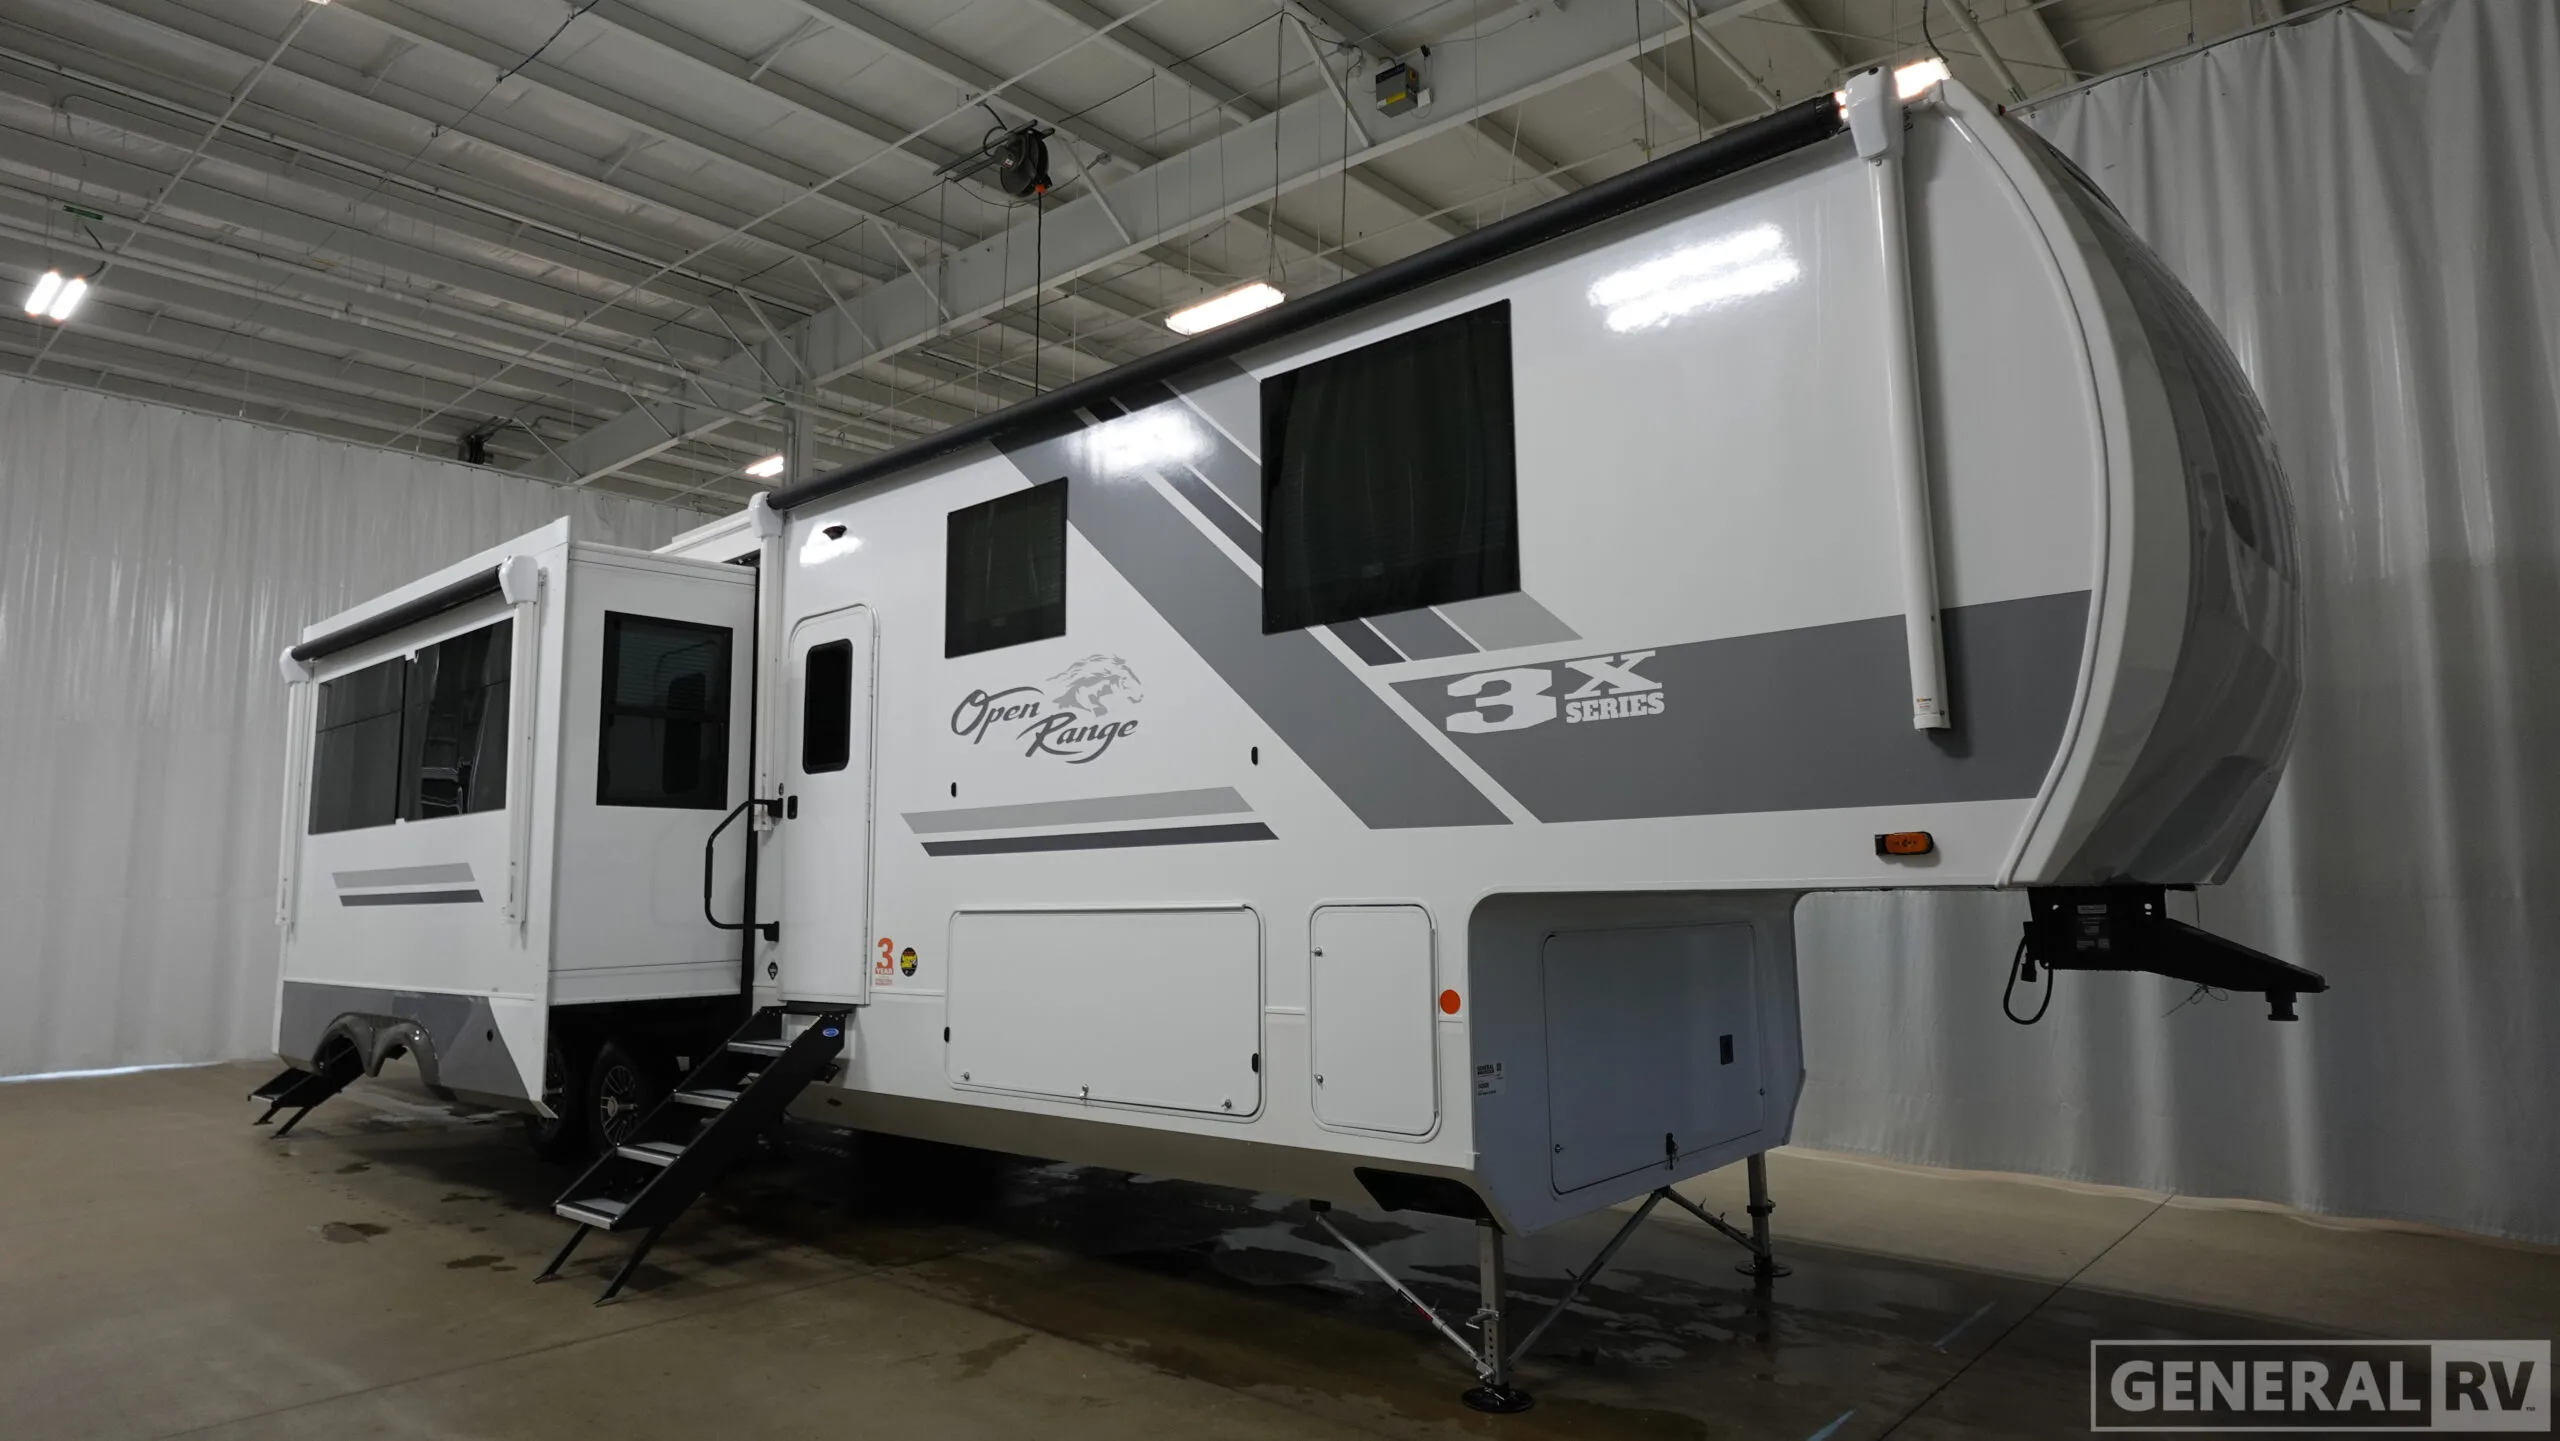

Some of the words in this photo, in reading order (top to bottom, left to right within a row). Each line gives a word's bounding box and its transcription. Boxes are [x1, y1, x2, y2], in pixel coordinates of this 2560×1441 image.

[951, 686, 1045, 745] Open
[1445, 667, 1558, 734] 3
[1564, 649, 1663, 701] X
[1565, 692, 1665, 724] SERIES
[1016, 711, 1139, 764] Range
[877, 937, 893, 968] 3
